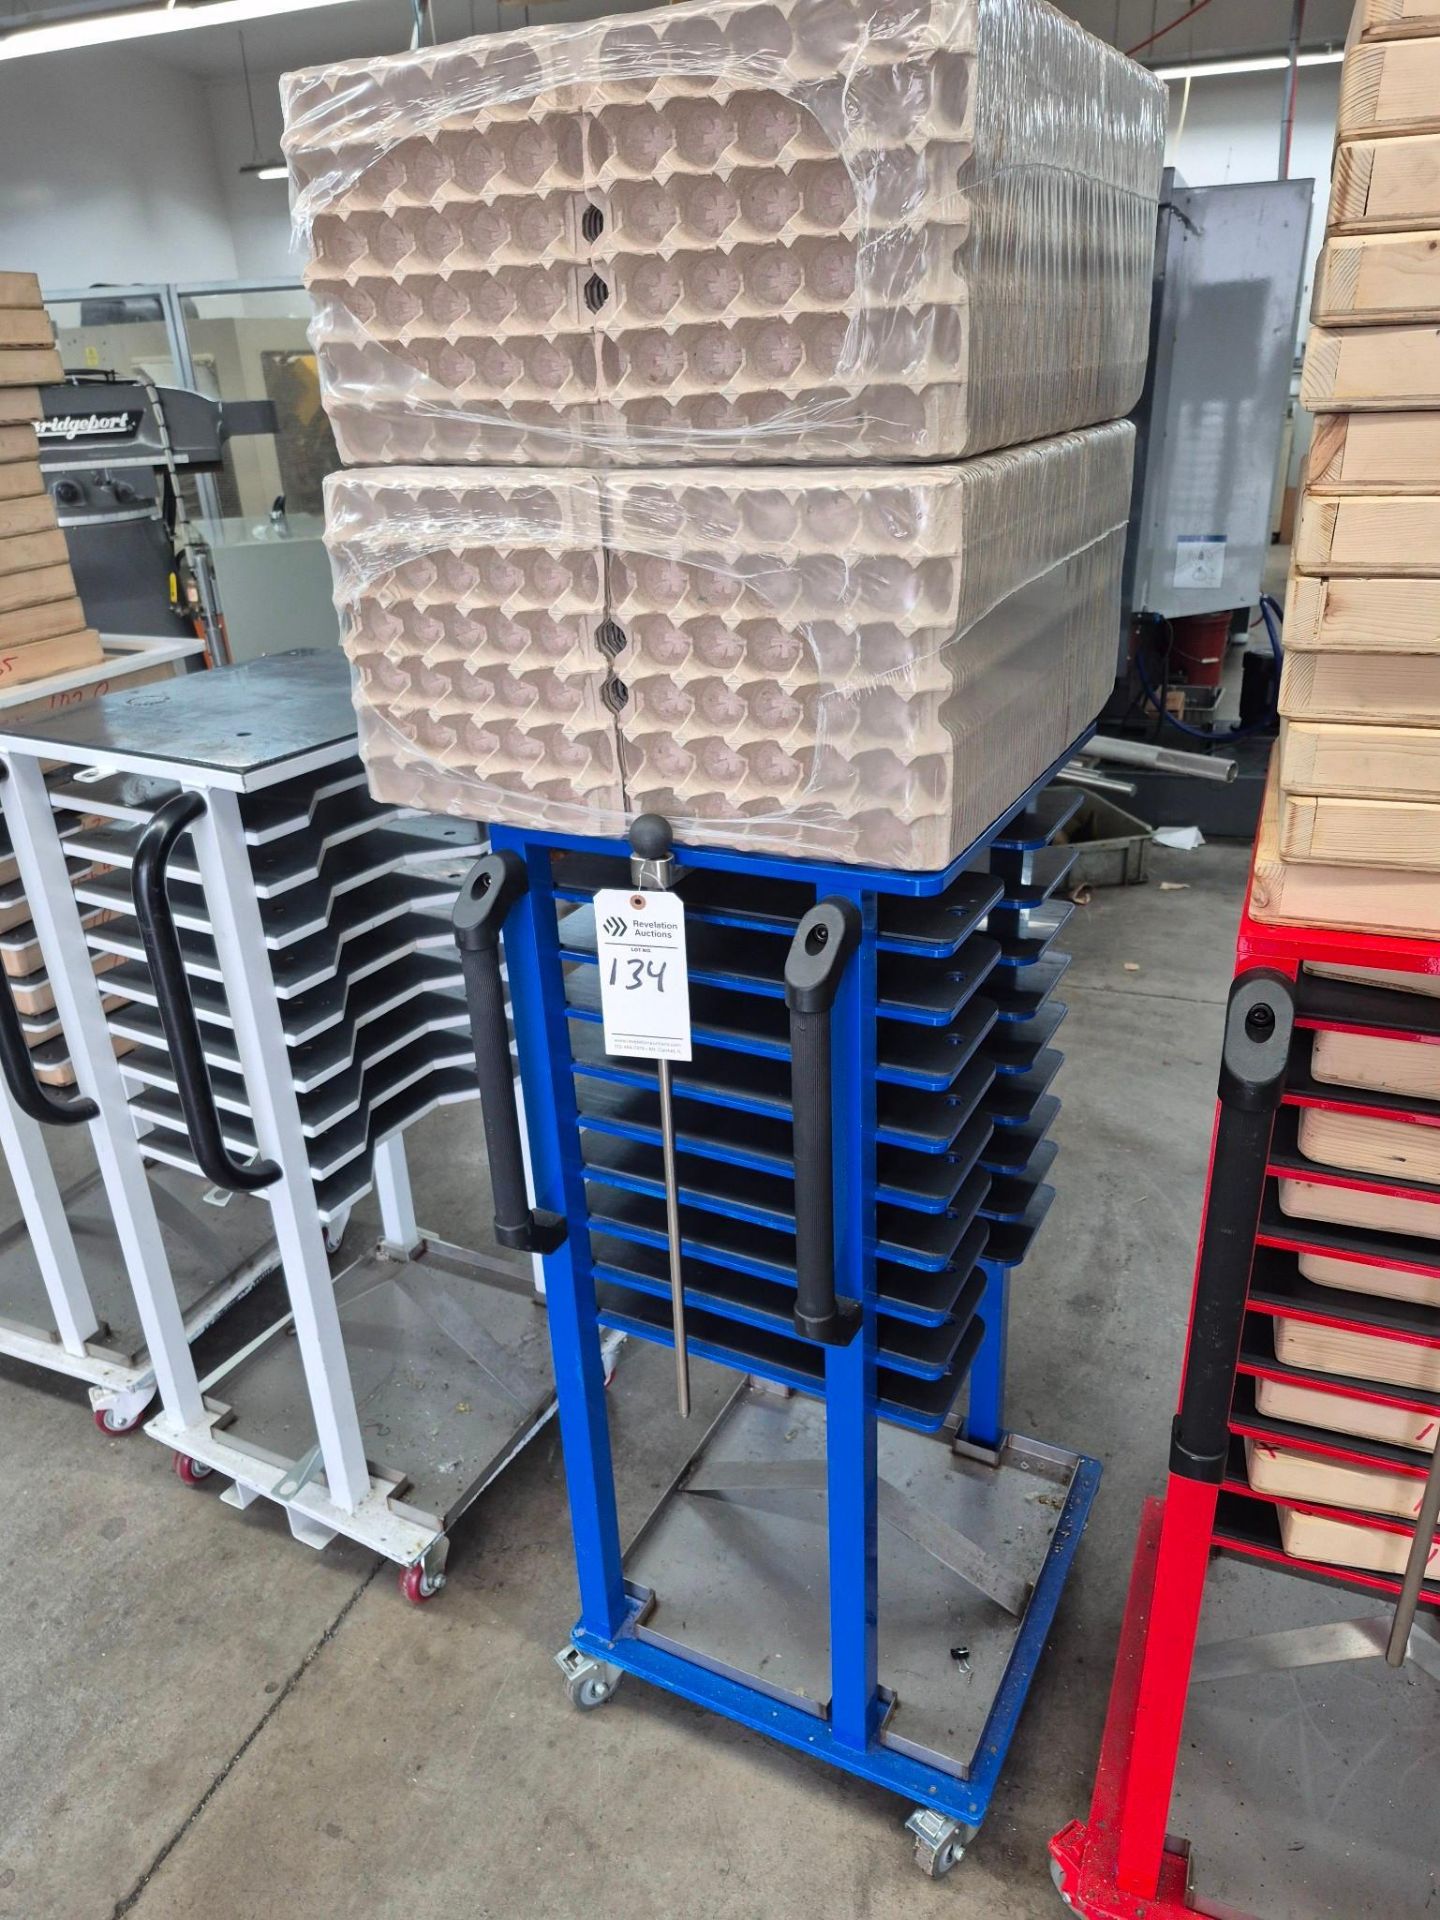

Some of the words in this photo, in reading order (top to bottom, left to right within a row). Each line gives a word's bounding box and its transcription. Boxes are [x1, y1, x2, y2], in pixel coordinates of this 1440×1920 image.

[32, 412, 128, 440] ridgeport
[632, 919, 678, 930] Revelation
[634, 929, 673, 939] Auctions
[609, 958, 667, 993] 134
